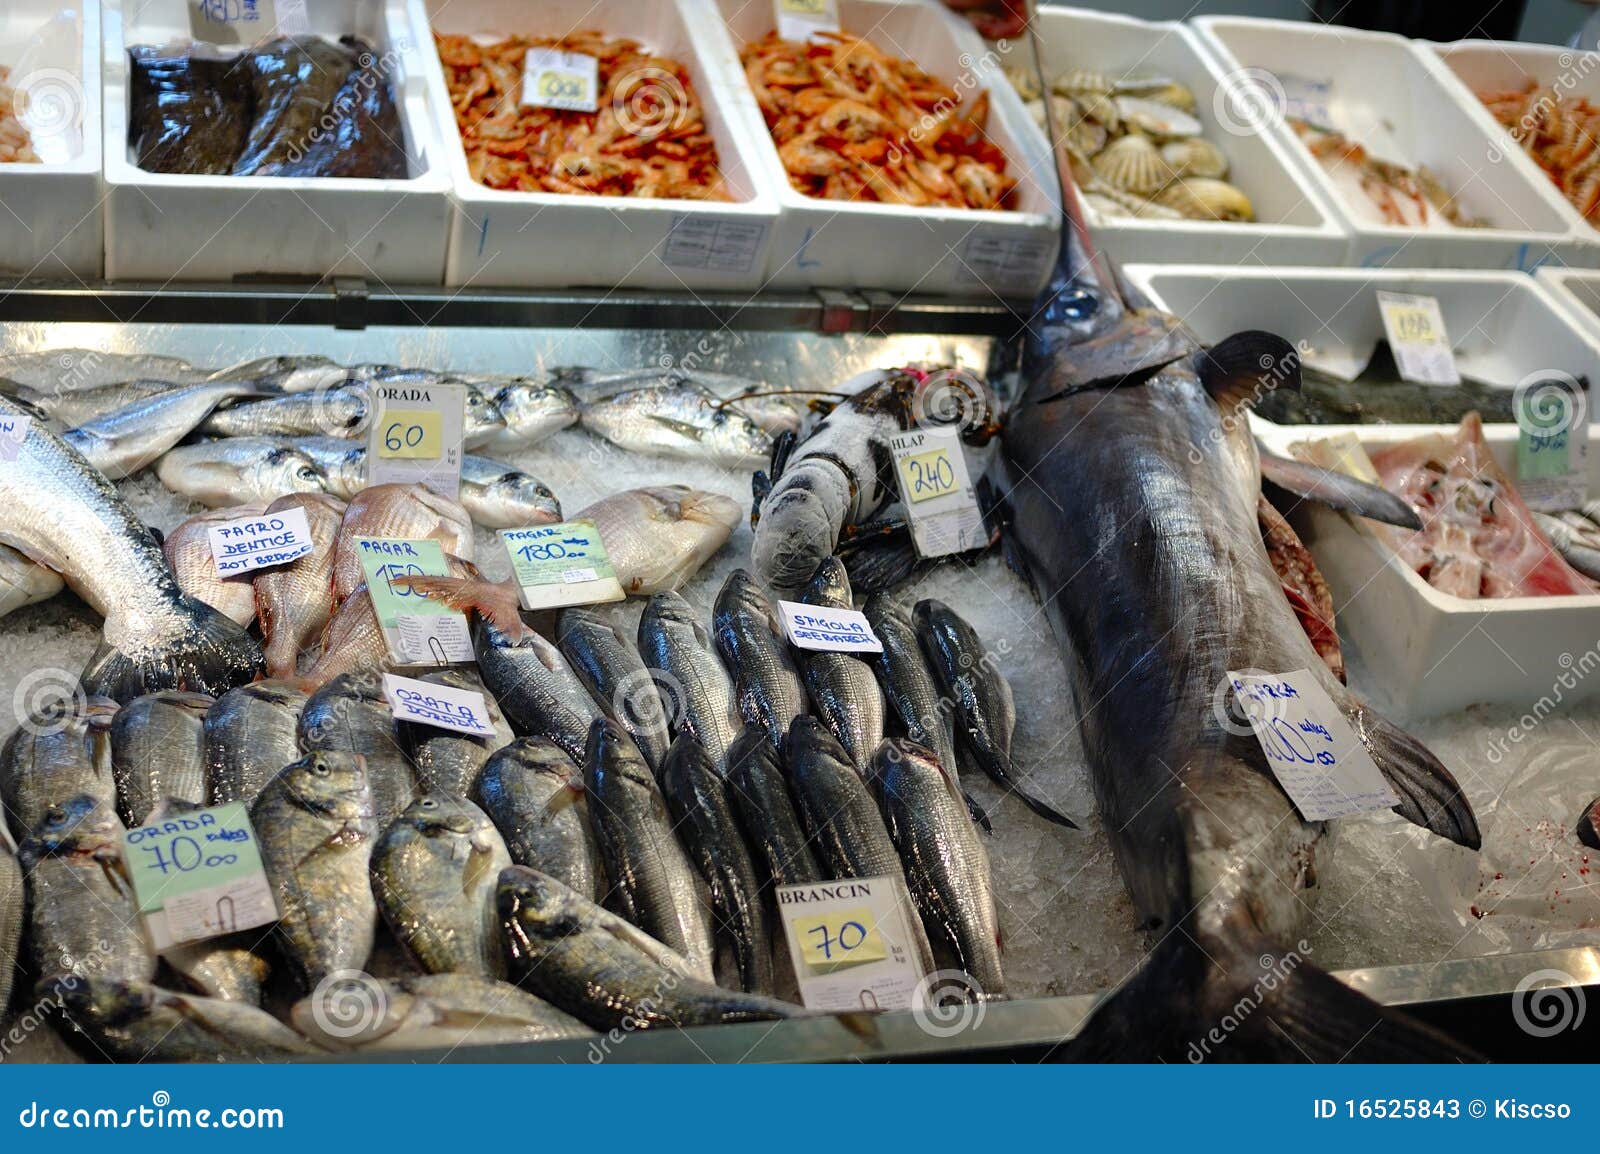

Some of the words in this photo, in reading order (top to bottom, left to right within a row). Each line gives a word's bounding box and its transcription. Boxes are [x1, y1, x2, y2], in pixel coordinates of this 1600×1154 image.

[376, 387, 431, 402] ORADA
[385, 422, 424, 452] 60
[891, 434, 925, 450] HLAP
[910, 455, 954, 493] 240
[217, 518, 285, 538] PAGRO
[503, 528, 563, 541] PAGAR
[223, 531, 296, 554] DENTICE
[360, 540, 419, 557] PAGAR
[517, 543, 566, 562] 180
[376, 563, 430, 598] 150
[793, 615, 864, 633] SPIGOLA
[396, 688, 479, 721] ORATA
[127, 813, 216, 844] ORADA
[141, 835, 202, 875] 70
[779, 883, 872, 905] BRANCIN
[807, 920, 867, 959] 70
